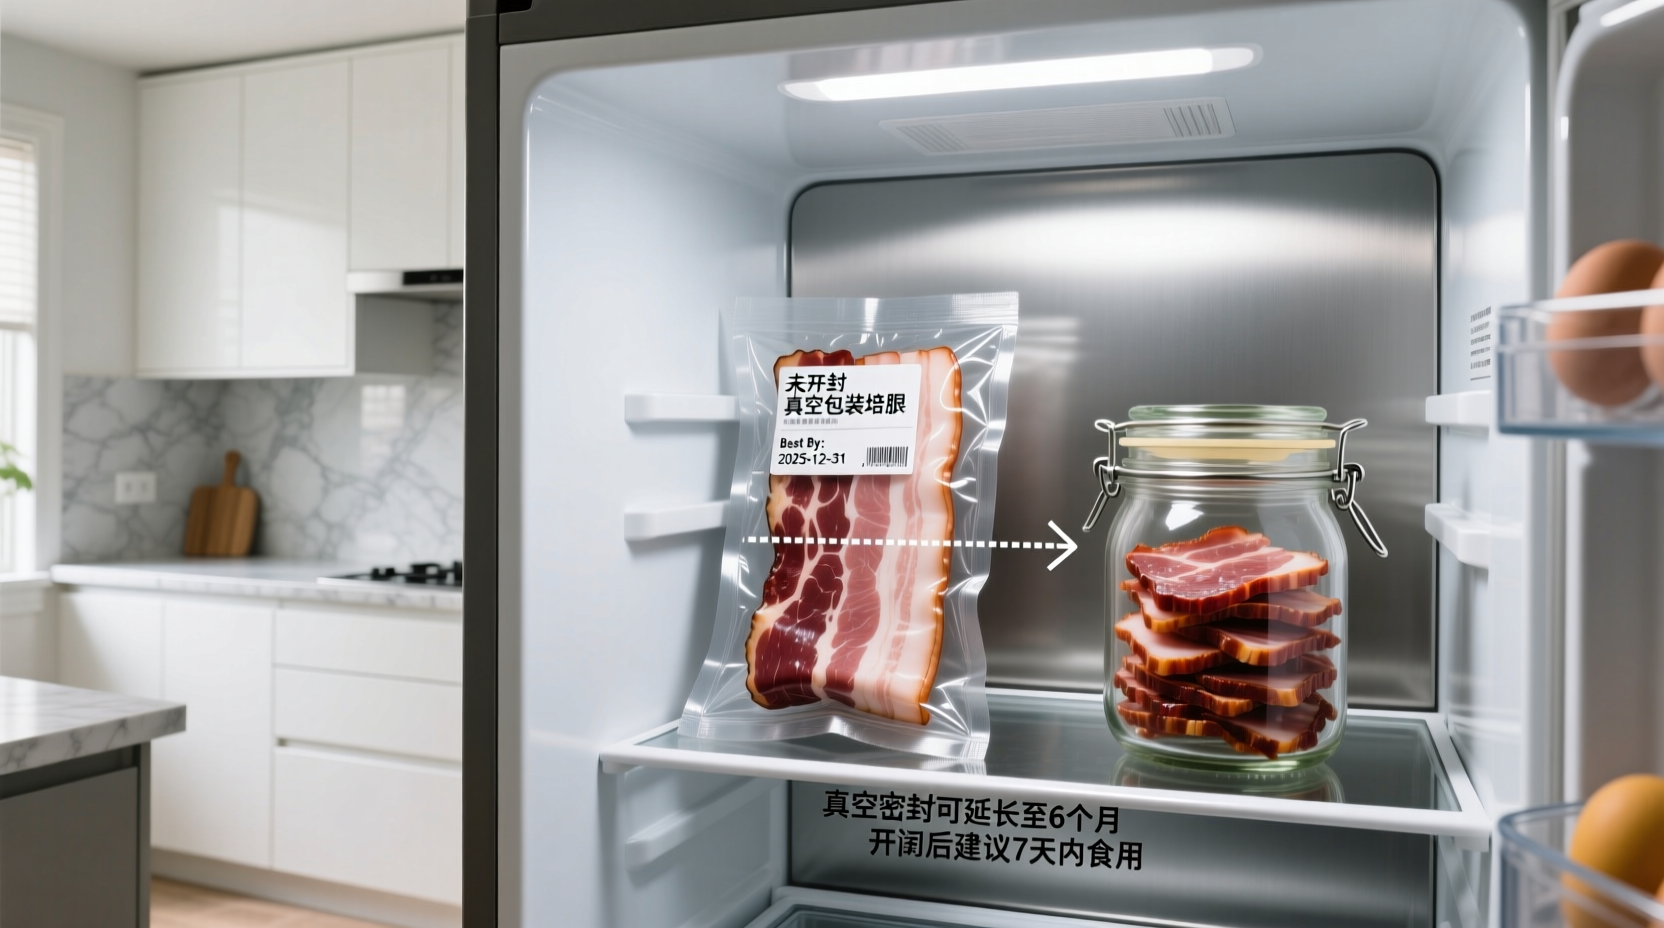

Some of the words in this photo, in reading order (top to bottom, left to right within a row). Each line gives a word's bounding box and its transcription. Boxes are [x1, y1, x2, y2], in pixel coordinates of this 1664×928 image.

[785, 372, 847, 393] 未开封
[780, 437, 804, 449] Best
[807, 437, 825, 451] By:
[778, 452, 846, 465] 2025-12-31
[822, 789, 1119, 834] 真空密封可延长至6个月
